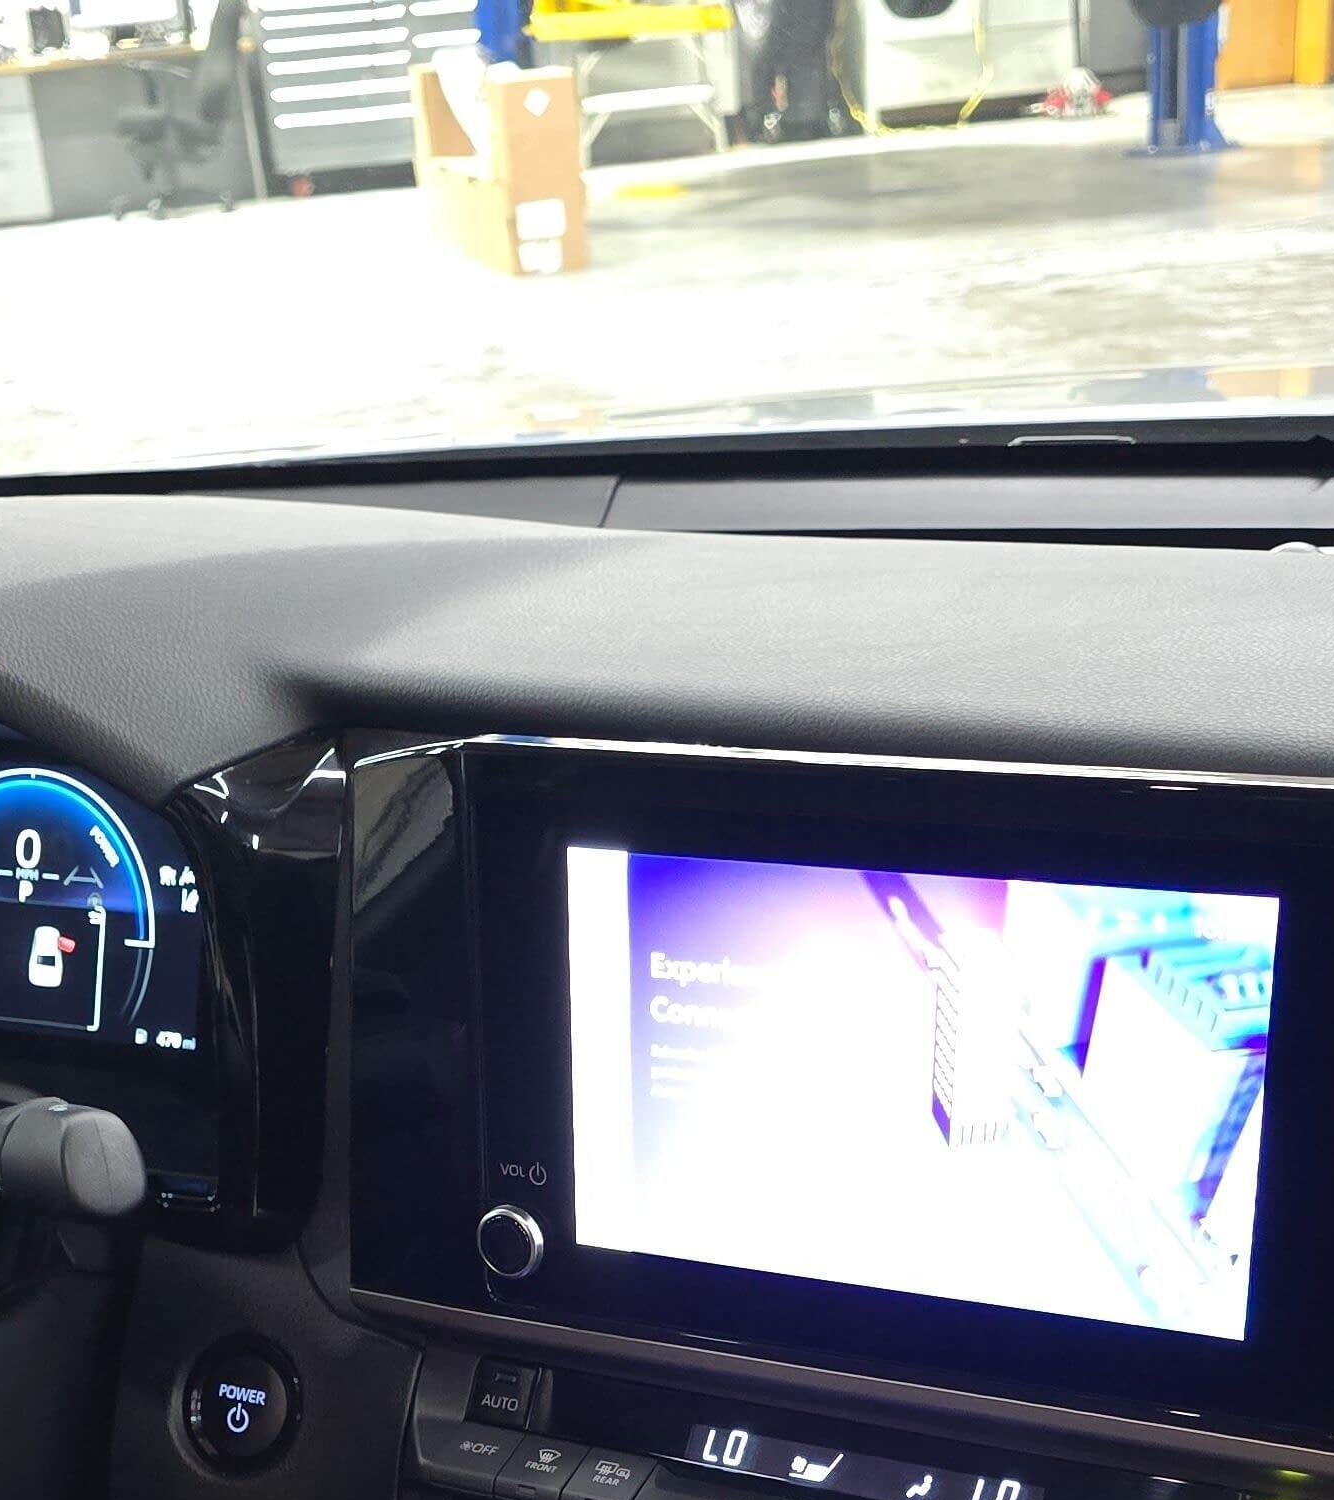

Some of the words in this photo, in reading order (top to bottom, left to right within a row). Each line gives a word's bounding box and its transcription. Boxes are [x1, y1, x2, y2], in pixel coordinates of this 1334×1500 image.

[14, 828, 42, 869] 0
[17, 878, 34, 903] P
[499, 1162, 526, 1178] VOL
[218, 1382, 267, 1406] POWER
[480, 1393, 519, 1412] AUTO
[471, 1442, 500, 1456] OFF
[701, 1428, 749, 1467] LO
[524, 1459, 558, 1474] FRONT
[592, 1474, 620, 1487] REAR
